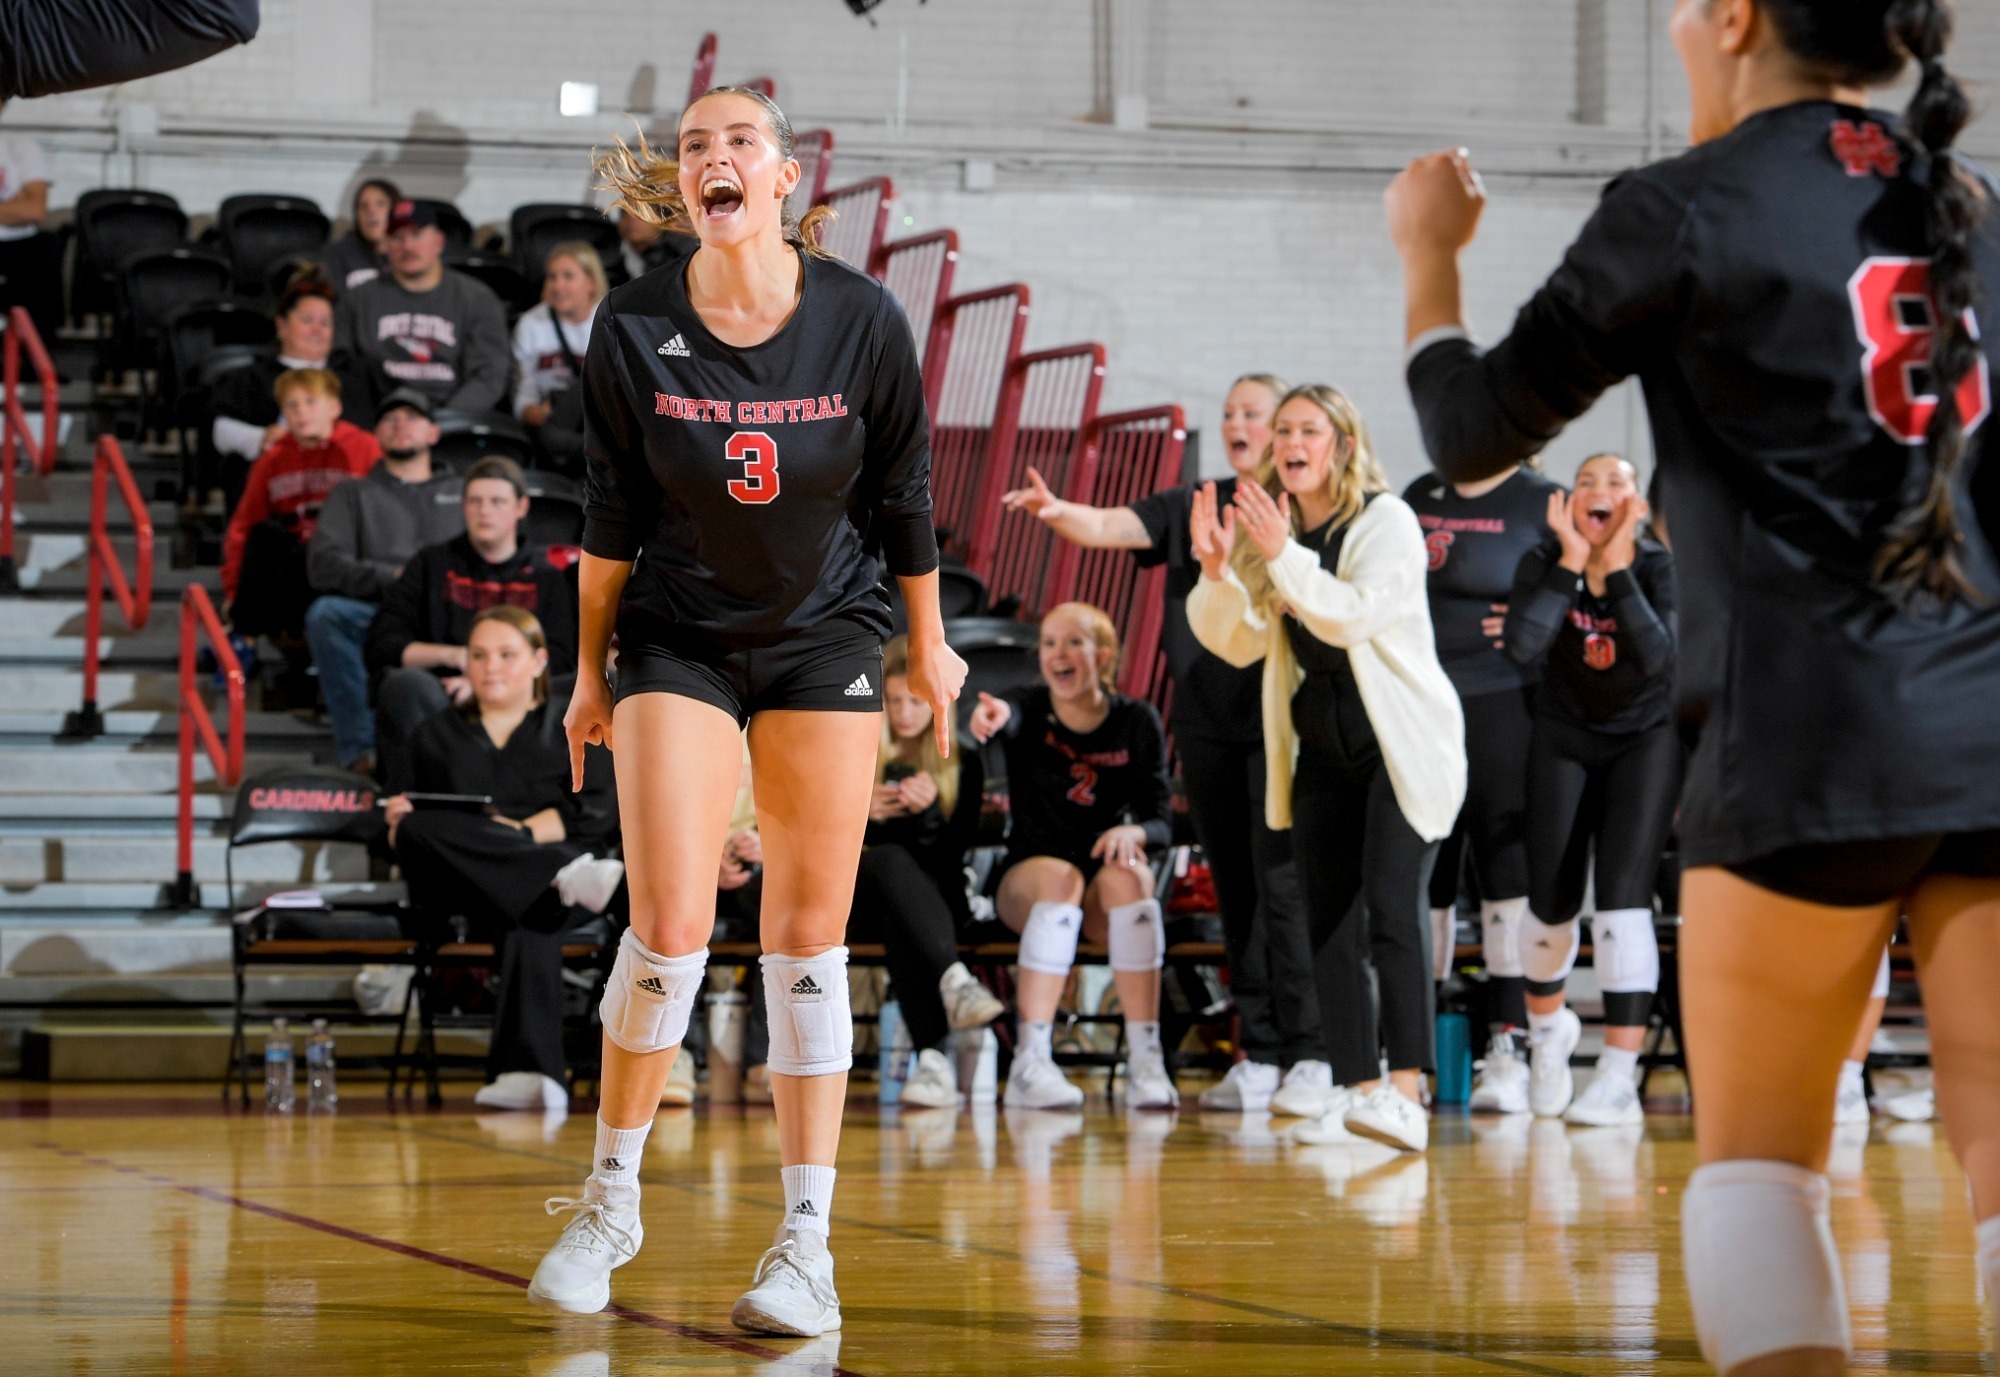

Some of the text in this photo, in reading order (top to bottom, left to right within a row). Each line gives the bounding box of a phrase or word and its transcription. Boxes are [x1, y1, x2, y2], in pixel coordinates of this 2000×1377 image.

[657, 346, 691, 358] adidas
[1847, 256, 1990, 445] 8
[655, 392, 848, 424] NORTH CENTRAL
[725, 431, 780, 505] 3
[843, 687, 874, 696] adidas
[1066, 762, 1098, 807] 2
[249, 787, 375, 812] CARDINALS
[636, 980, 667, 996] adidas
[790, 986, 822, 995] adidas
